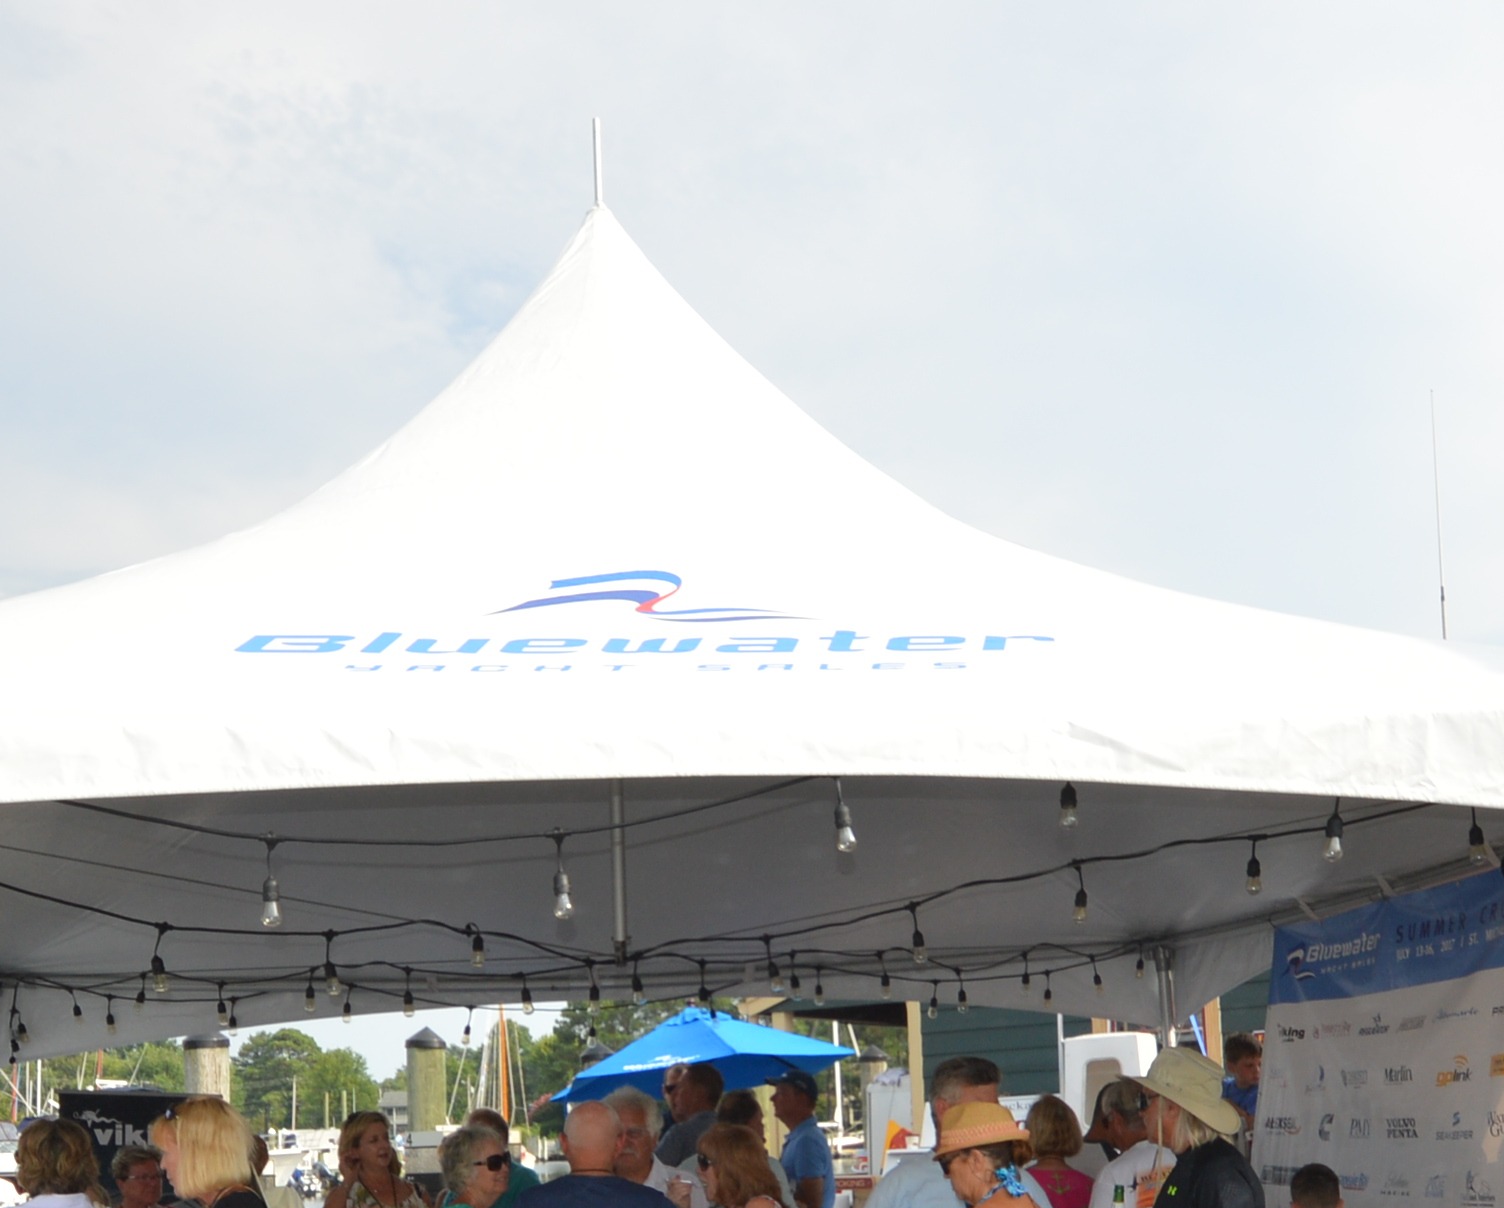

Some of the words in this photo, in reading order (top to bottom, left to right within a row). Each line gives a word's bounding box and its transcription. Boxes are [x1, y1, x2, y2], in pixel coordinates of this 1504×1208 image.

[233, 630, 1056, 655] Bluewater
[345, 664, 640, 674] YACHT
[696, 662, 968, 674] SALES
[1395, 911, 1467, 944] SUMMER
[1305, 932, 1382, 963] Bluewater
[1384, 1065, 1413, 1082] Marlin
[1386, 1117, 1416, 1128] VOLVO
[1386, 1128, 1419, 1139] PENTA
[1435, 1129, 1473, 1141] SEAKEEPER
